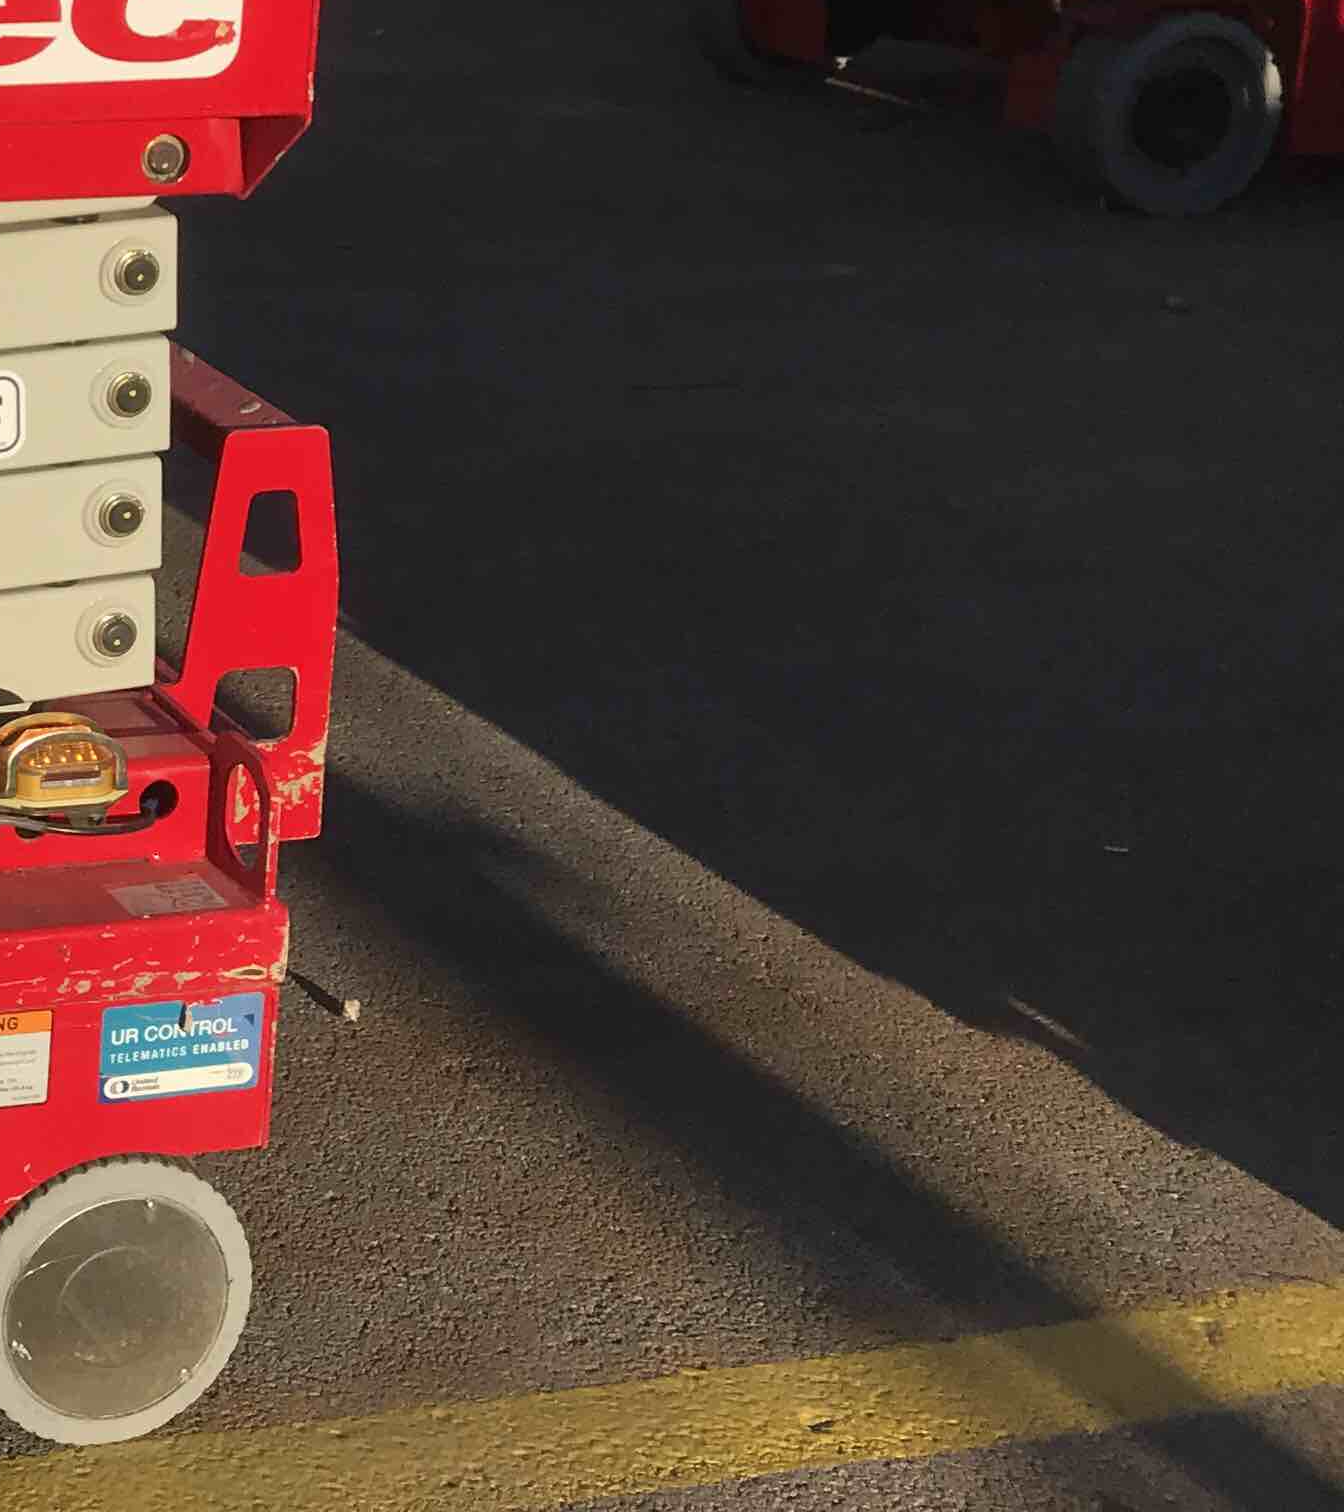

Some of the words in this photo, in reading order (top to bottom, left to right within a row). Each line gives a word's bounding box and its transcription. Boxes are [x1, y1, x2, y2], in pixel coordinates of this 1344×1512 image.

[111, 1027, 139, 1045] UR
[143, 1017, 238, 1042] CONTROL
[110, 1045, 187, 1065] TELEMATICS
[192, 1038, 249, 1055] ENABLED
